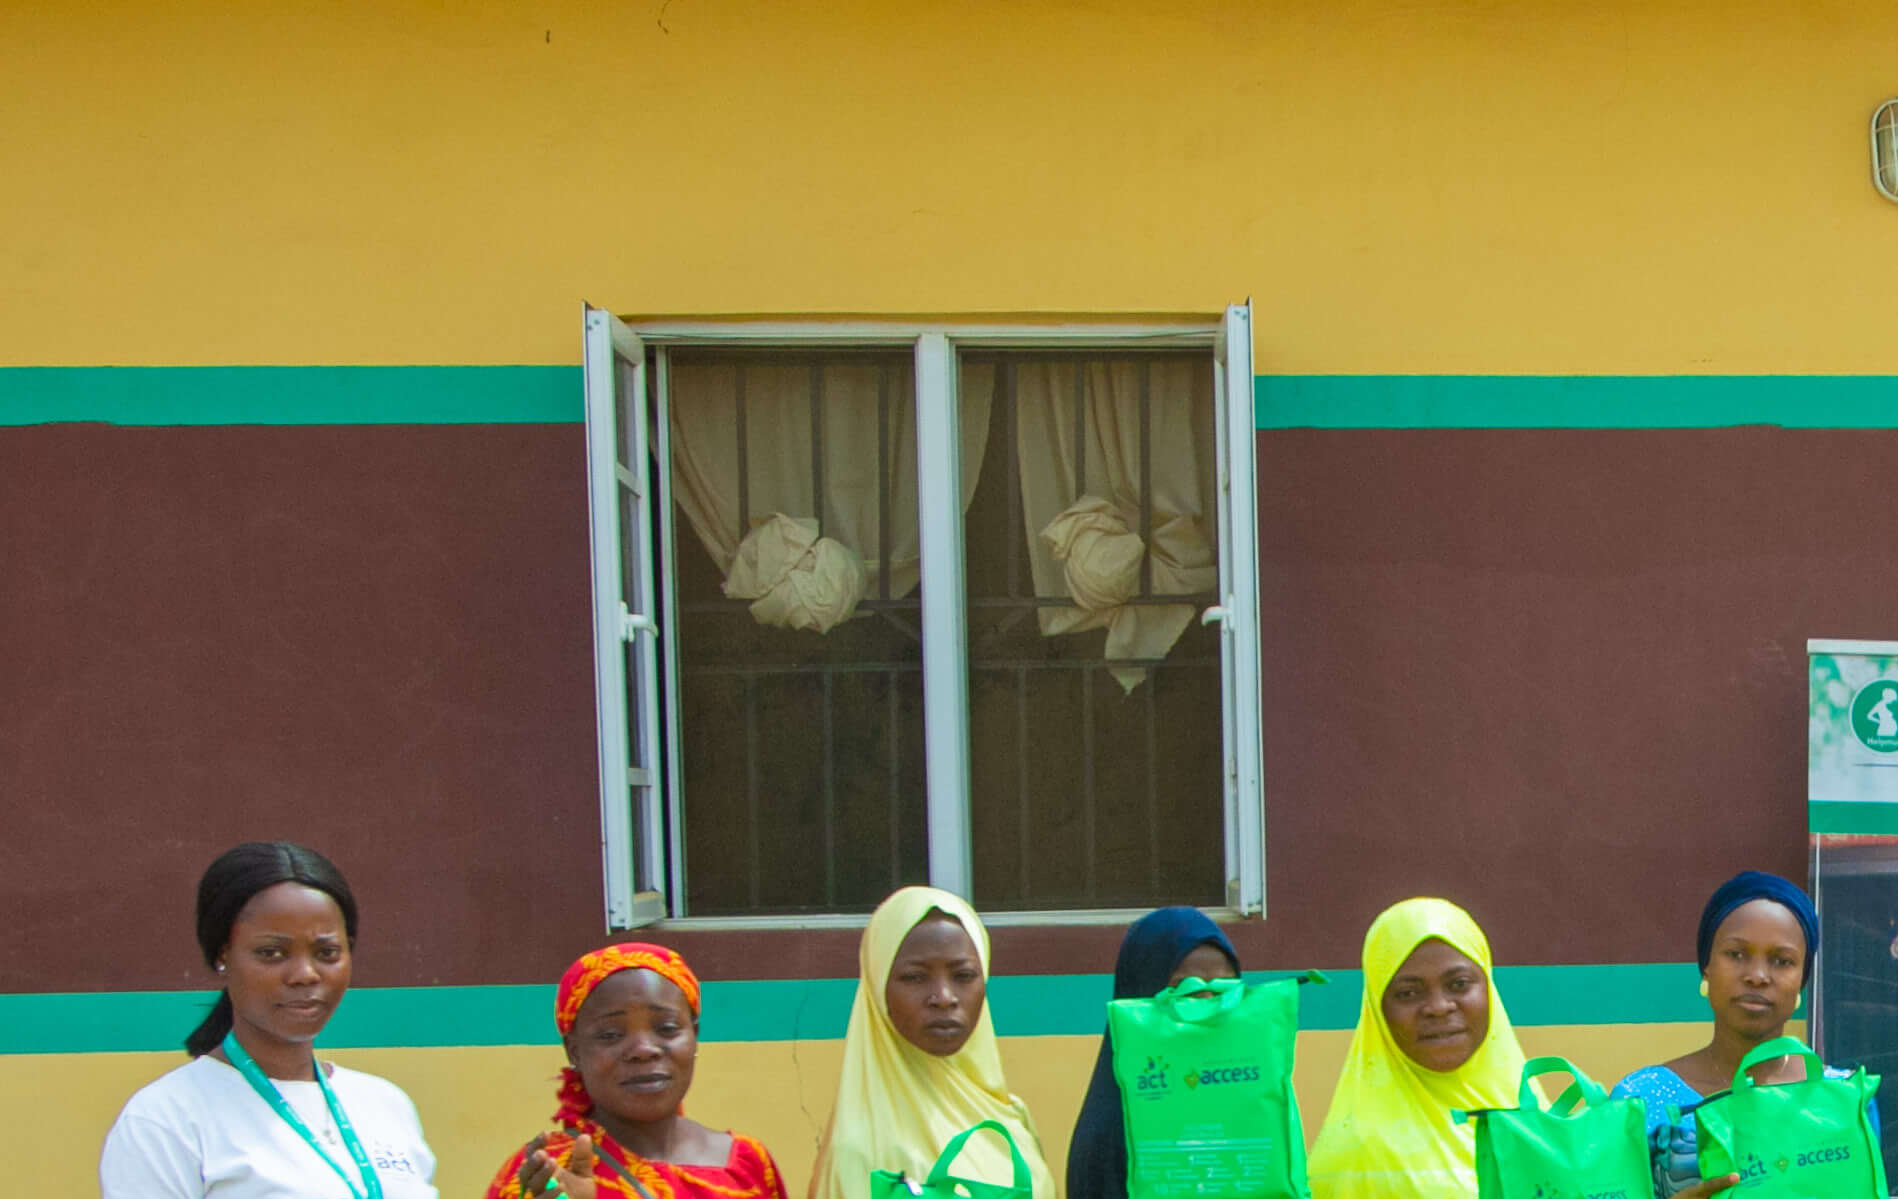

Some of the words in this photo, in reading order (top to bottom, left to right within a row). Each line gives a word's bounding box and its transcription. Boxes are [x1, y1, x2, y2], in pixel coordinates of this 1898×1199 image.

[1137, 1071, 1168, 1091] act
[1200, 1065, 1261, 1085] access
[1797, 1145, 1850, 1168] access
